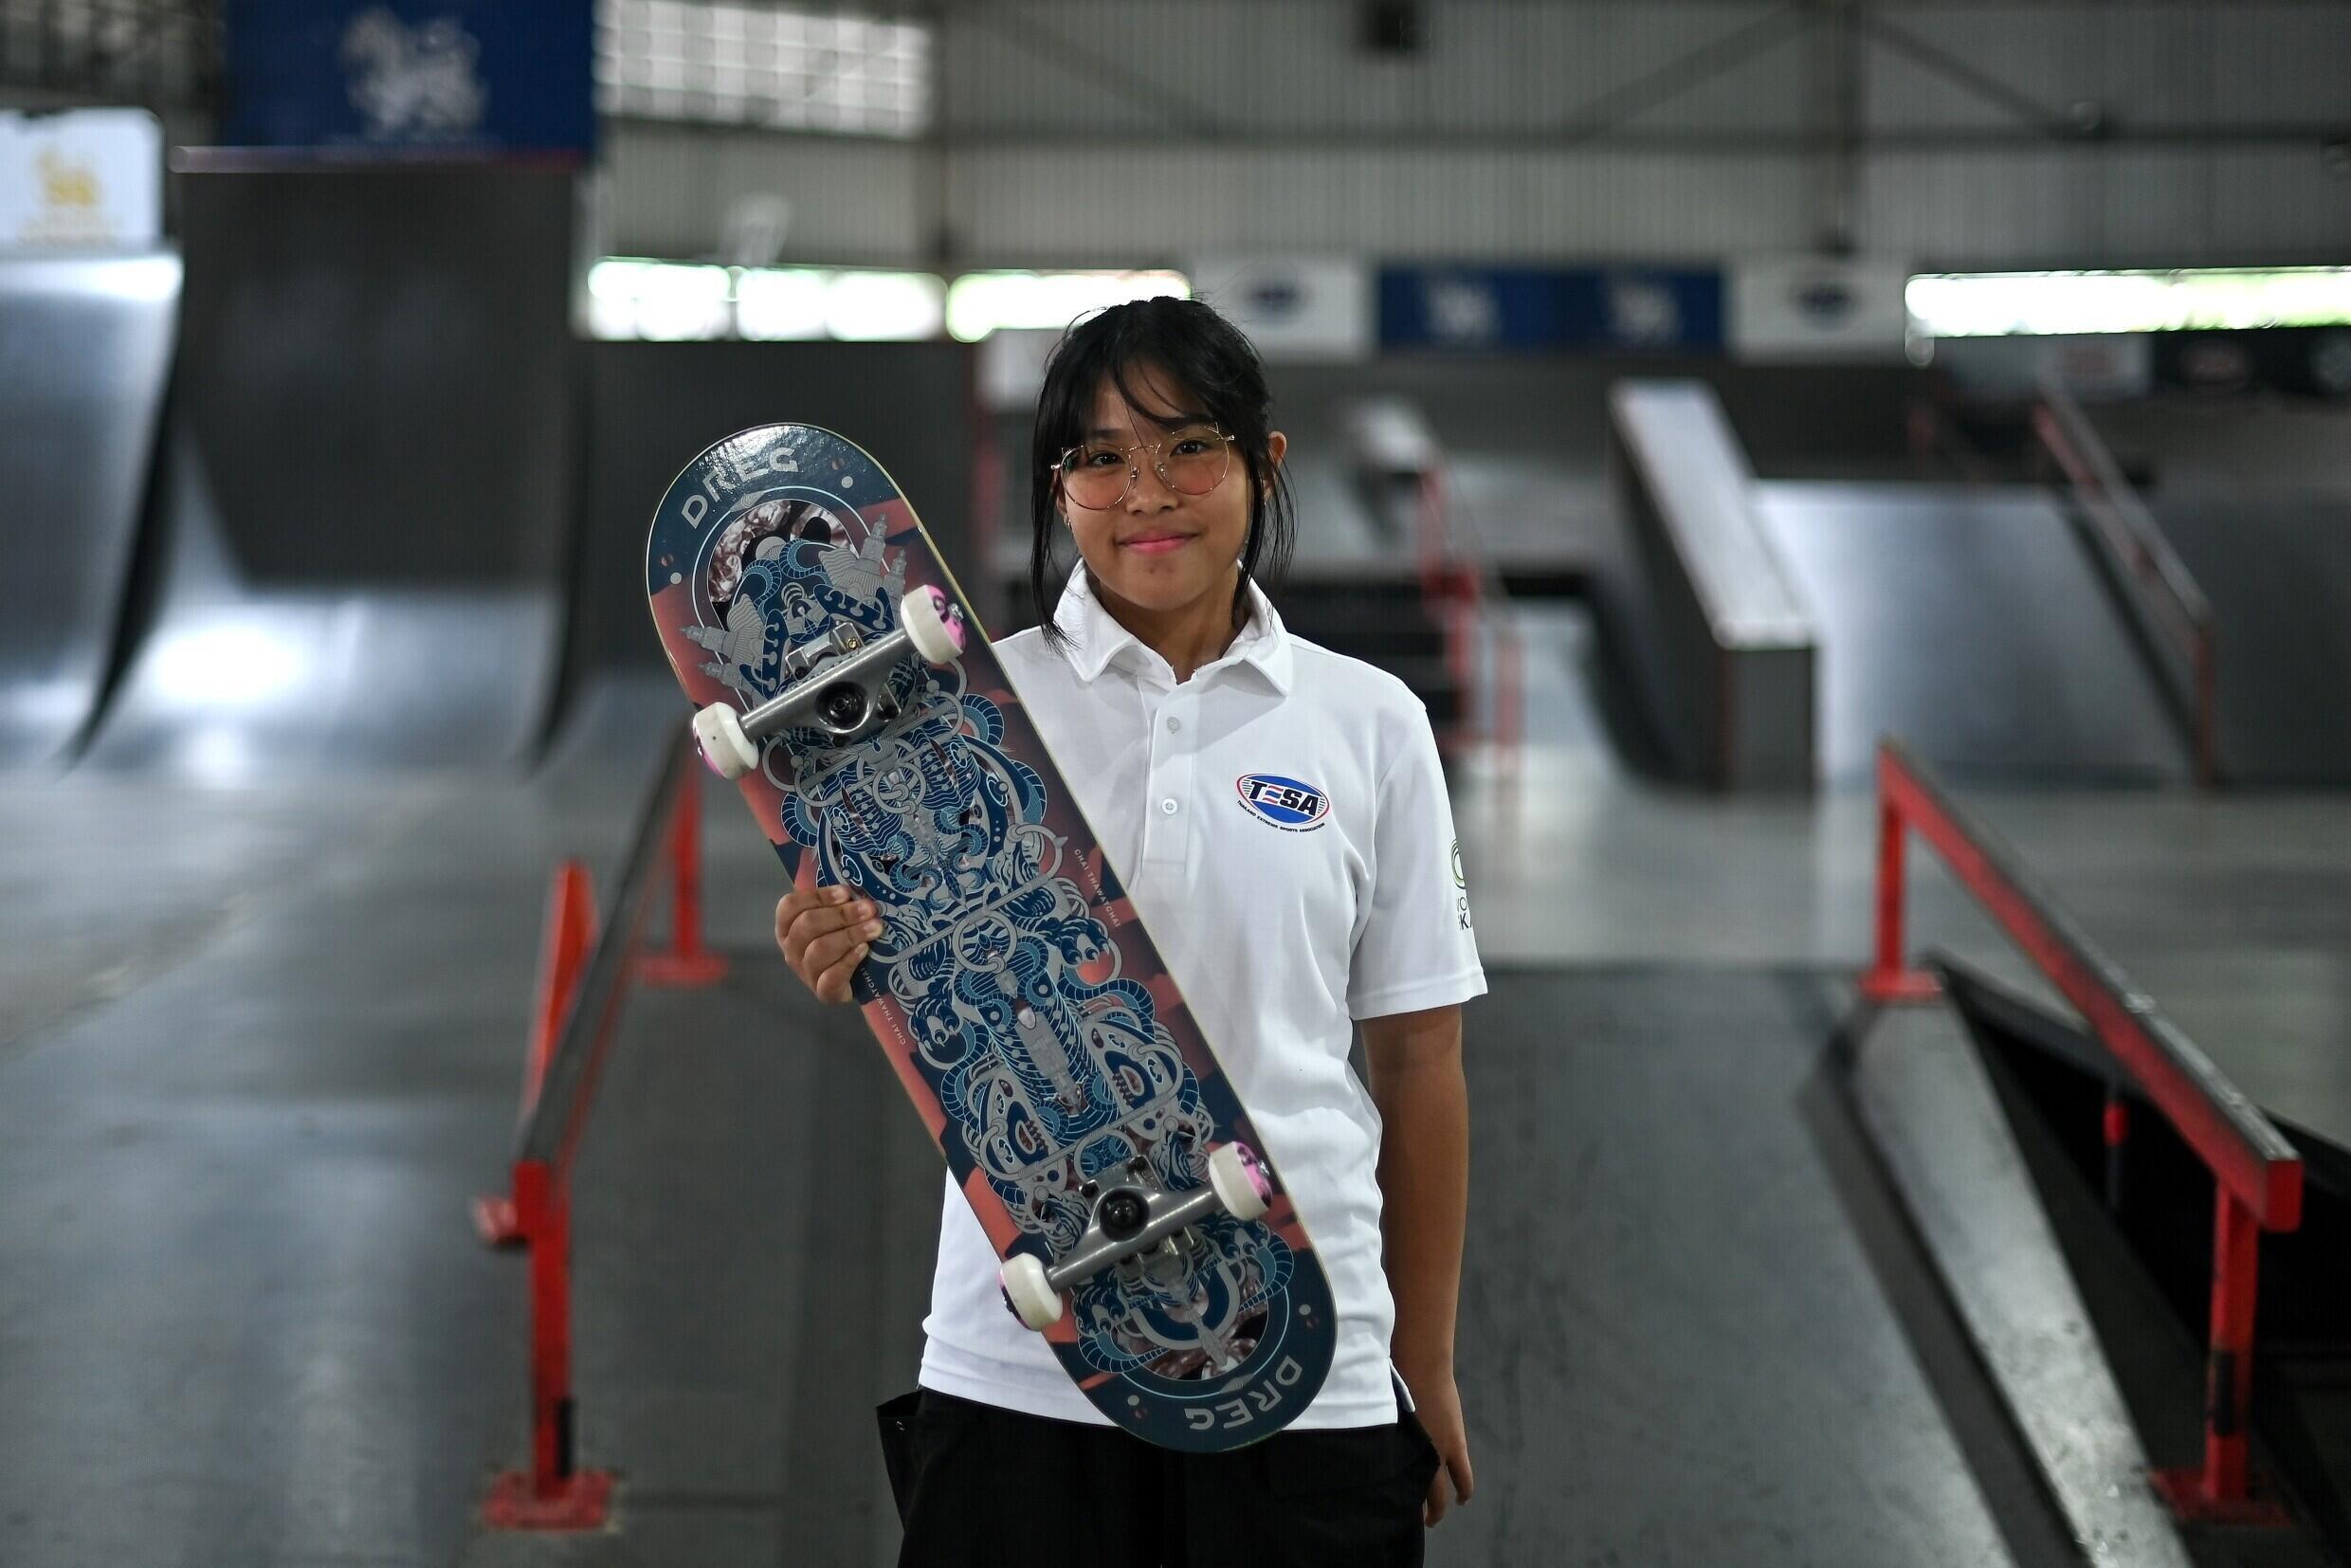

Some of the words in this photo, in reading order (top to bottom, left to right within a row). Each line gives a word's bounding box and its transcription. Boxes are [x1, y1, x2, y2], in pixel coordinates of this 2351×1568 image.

[682, 447, 799, 529] DREG
[1257, 816, 1278, 829] EXTREME
[1074, 848, 1089, 869] CHAI
[1087, 872, 1121, 927] THAWATCHAI
[860, 967, 893, 1021] THAWATCHAI
[891, 1024, 906, 1046] CHAI
[1184, 1355, 1303, 1431] DREG
